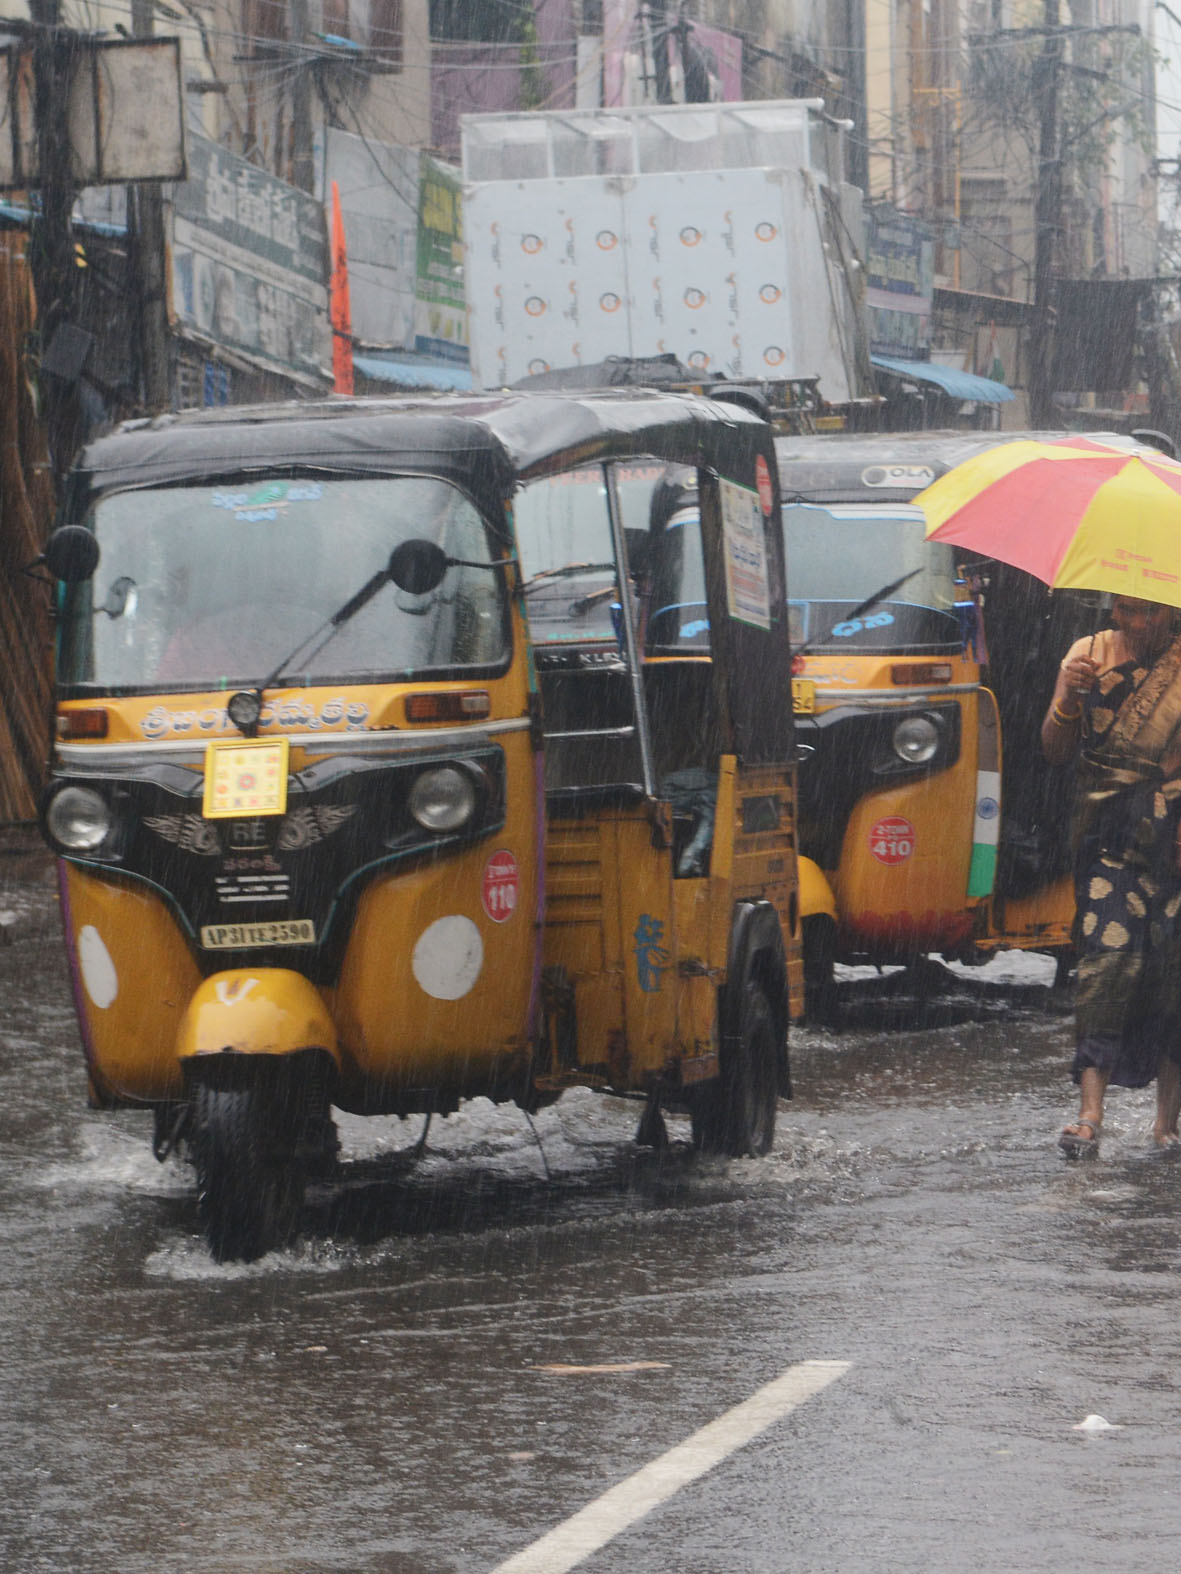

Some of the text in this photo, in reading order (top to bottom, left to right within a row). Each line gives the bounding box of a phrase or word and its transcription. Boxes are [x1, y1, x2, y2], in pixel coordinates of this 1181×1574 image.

[889, 467, 931, 478] OLA
[232, 822, 267, 841] RE
[872, 841, 911, 857] 410
